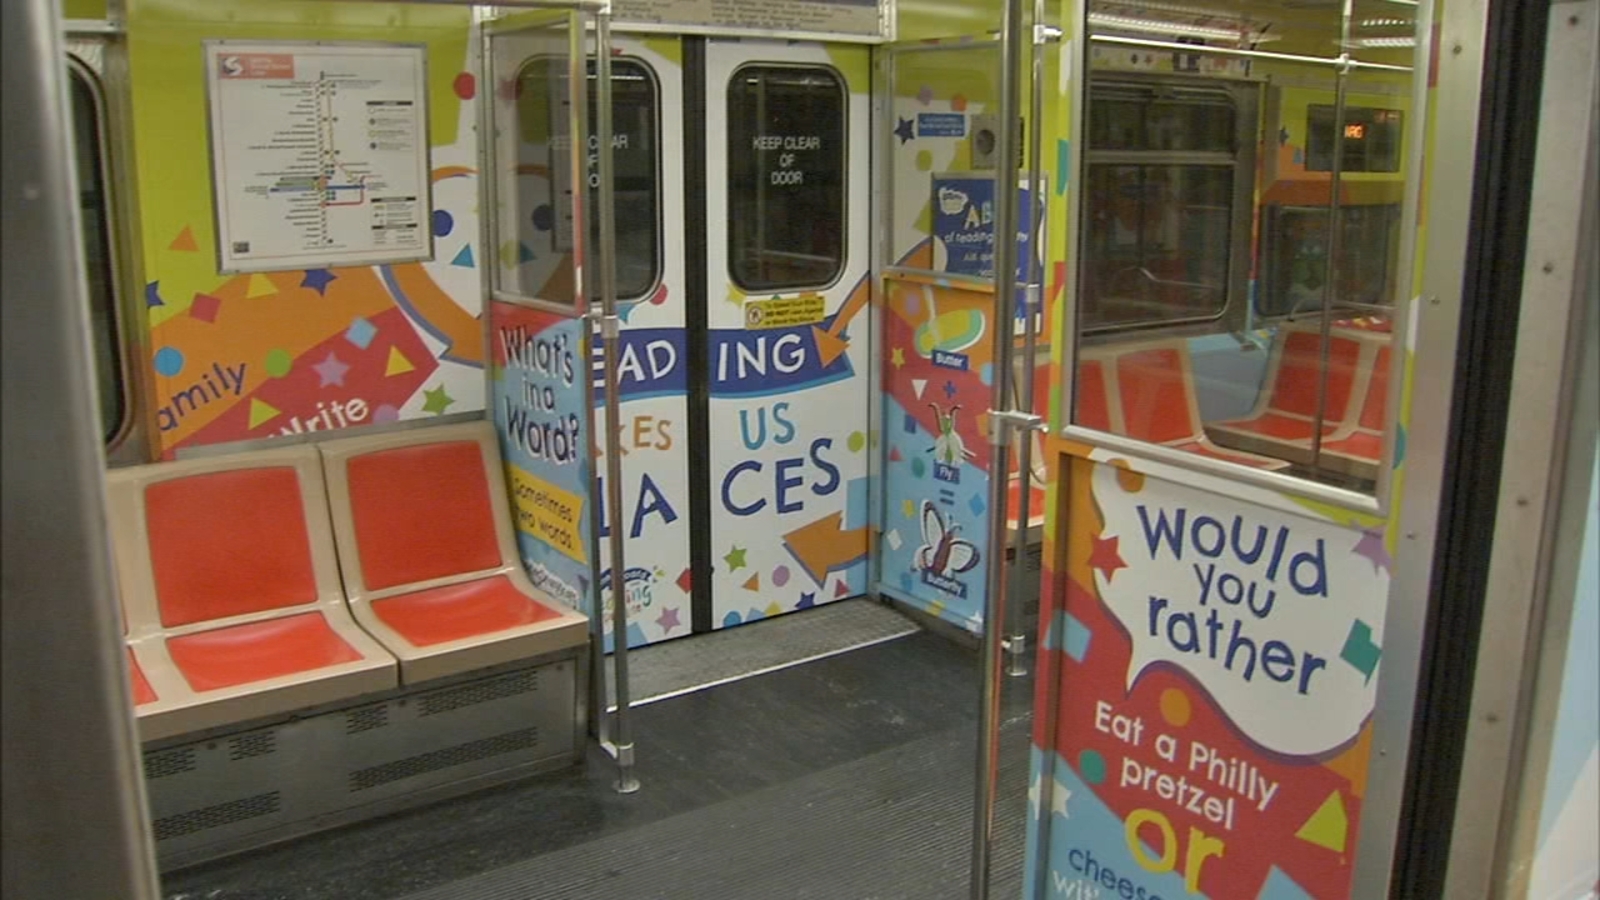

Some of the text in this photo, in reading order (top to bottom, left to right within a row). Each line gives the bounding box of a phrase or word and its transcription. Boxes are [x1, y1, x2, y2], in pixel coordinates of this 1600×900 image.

[753, 136, 821, 150] KEEP CLEAR
[780, 153, 794, 168] OF
[771, 171, 803, 185] DOOR
[500, 324, 576, 388] What's
[935, 352, 964, 367] Butter
[522, 372, 555, 414] in a
[504, 395, 579, 465] Word?
[739, 402, 796, 450] US
[1136, 505, 1328, 598] Would
[1193, 563, 1276, 619] you
[1148, 596, 1327, 695] rather
[1095, 700, 1279, 812] Eat a Philly
[1120, 757, 1234, 830] pretzel
[1068, 848, 1163, 900] chees
